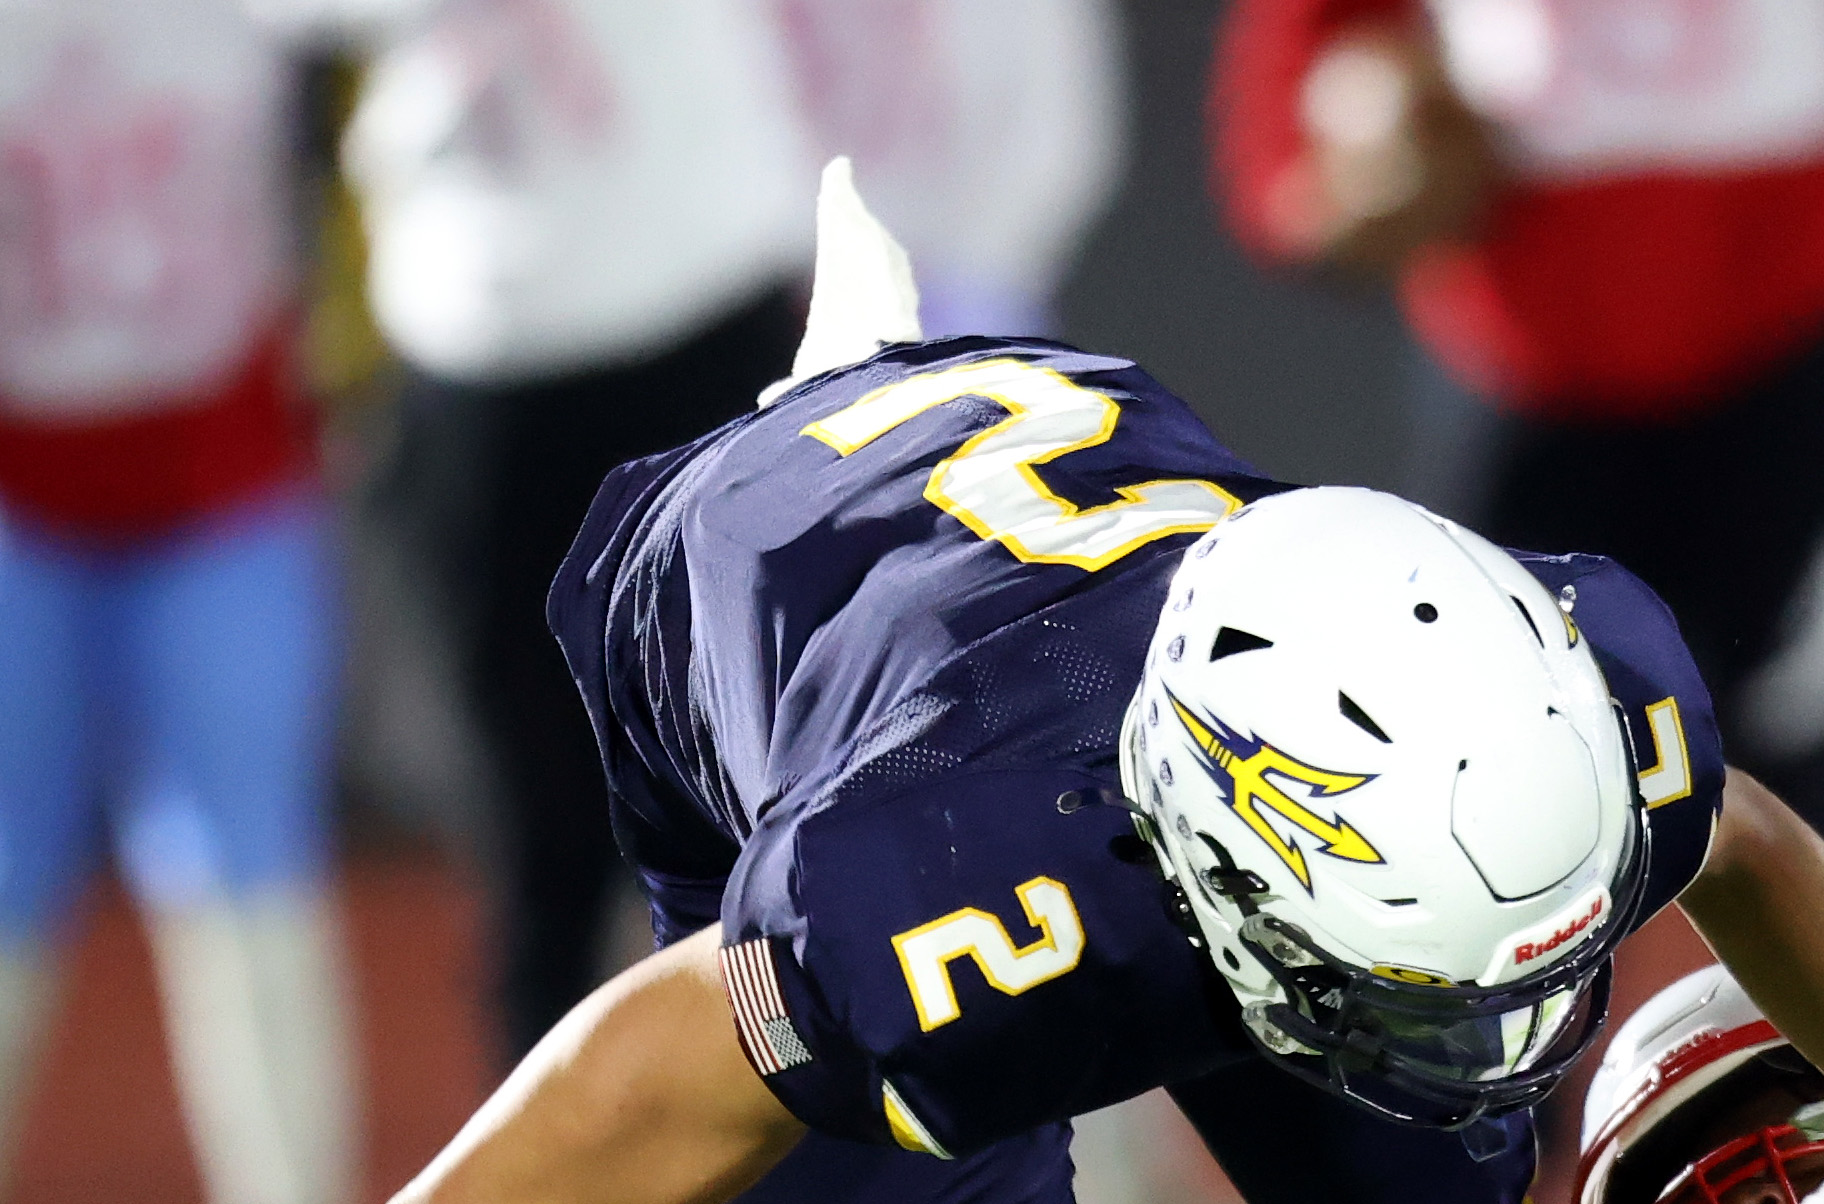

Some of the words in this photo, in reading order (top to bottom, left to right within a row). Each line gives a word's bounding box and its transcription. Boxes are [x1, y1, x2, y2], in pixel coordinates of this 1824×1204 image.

[800, 358, 1245, 572] 2
[891, 876, 1087, 1033] 2
[1514, 895, 1603, 965] Riddell
